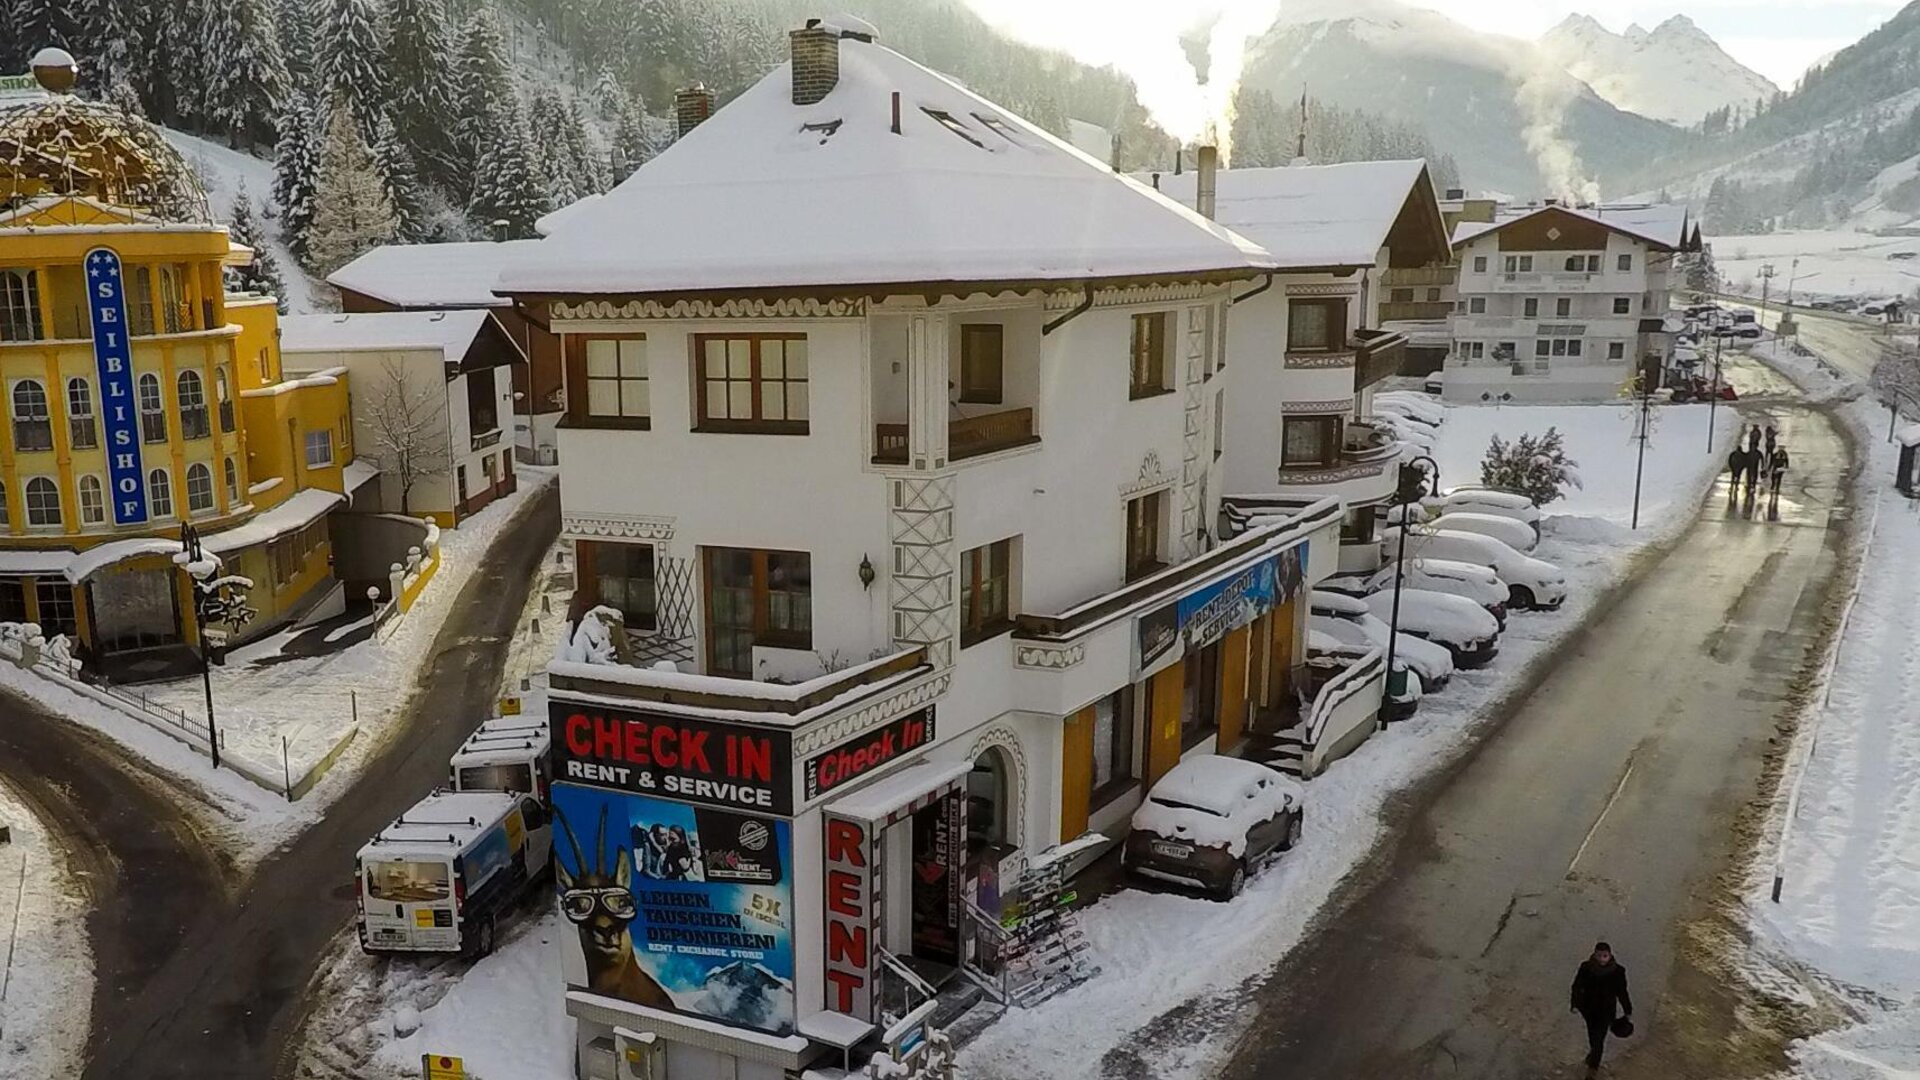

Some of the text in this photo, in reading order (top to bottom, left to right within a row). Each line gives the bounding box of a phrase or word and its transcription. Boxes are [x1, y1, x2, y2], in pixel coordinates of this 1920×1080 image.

[98, 282, 139, 517] SEIBLISHOF
[565, 714, 772, 783] CHECK IN
[567, 760, 773, 807] RENT & SERVICE
[808, 760, 817, 799] RENT
[818, 718, 925, 789] Check In
[827, 818, 867, 1015] RENT
